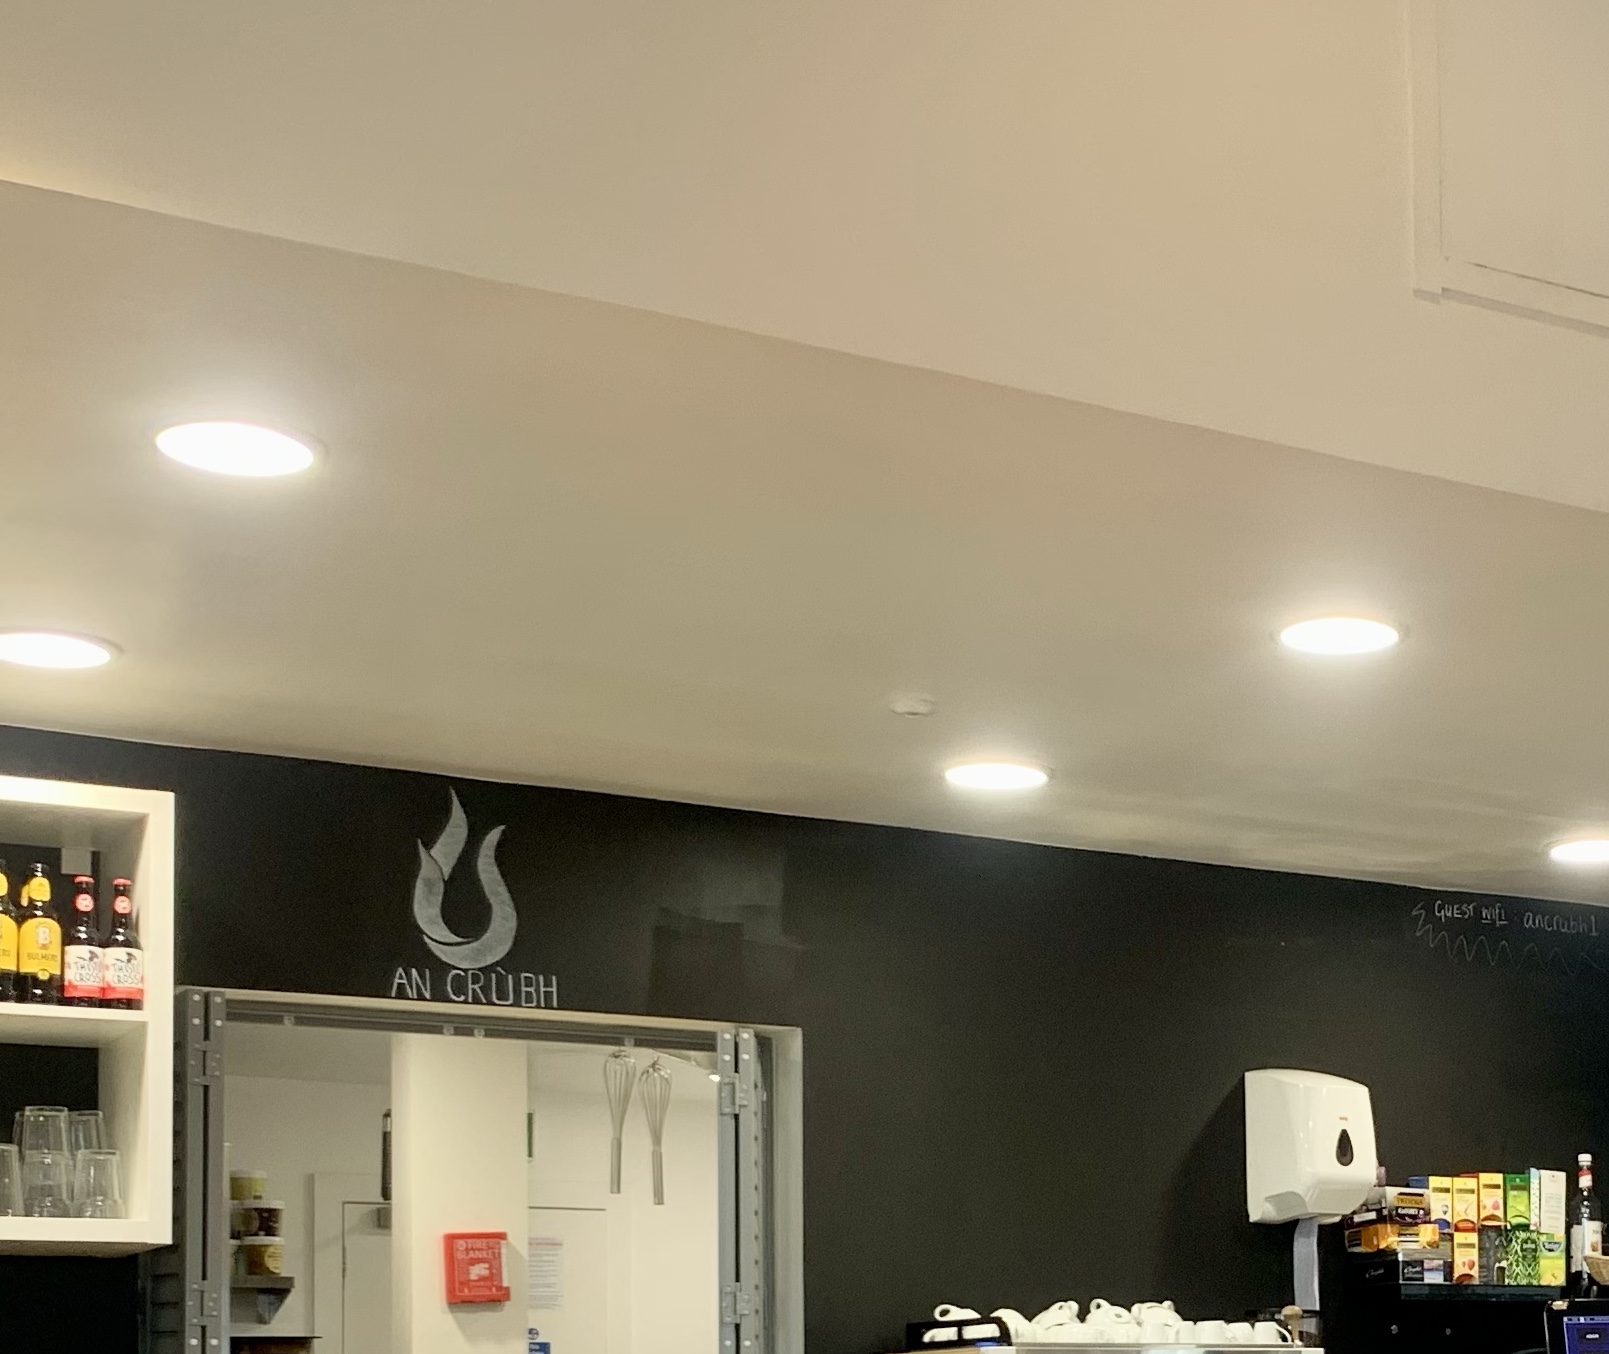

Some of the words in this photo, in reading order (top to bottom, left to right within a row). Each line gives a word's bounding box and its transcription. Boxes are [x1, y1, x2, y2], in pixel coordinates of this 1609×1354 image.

[1435, 900, 1476, 922] GUEST
[1524, 911, 1599, 936] ancrubh1
[391, 967, 430, 1000] AN
[447, 966, 558, 1008] CRÙBH
[457, 1249, 499, 1259] BLANKET
